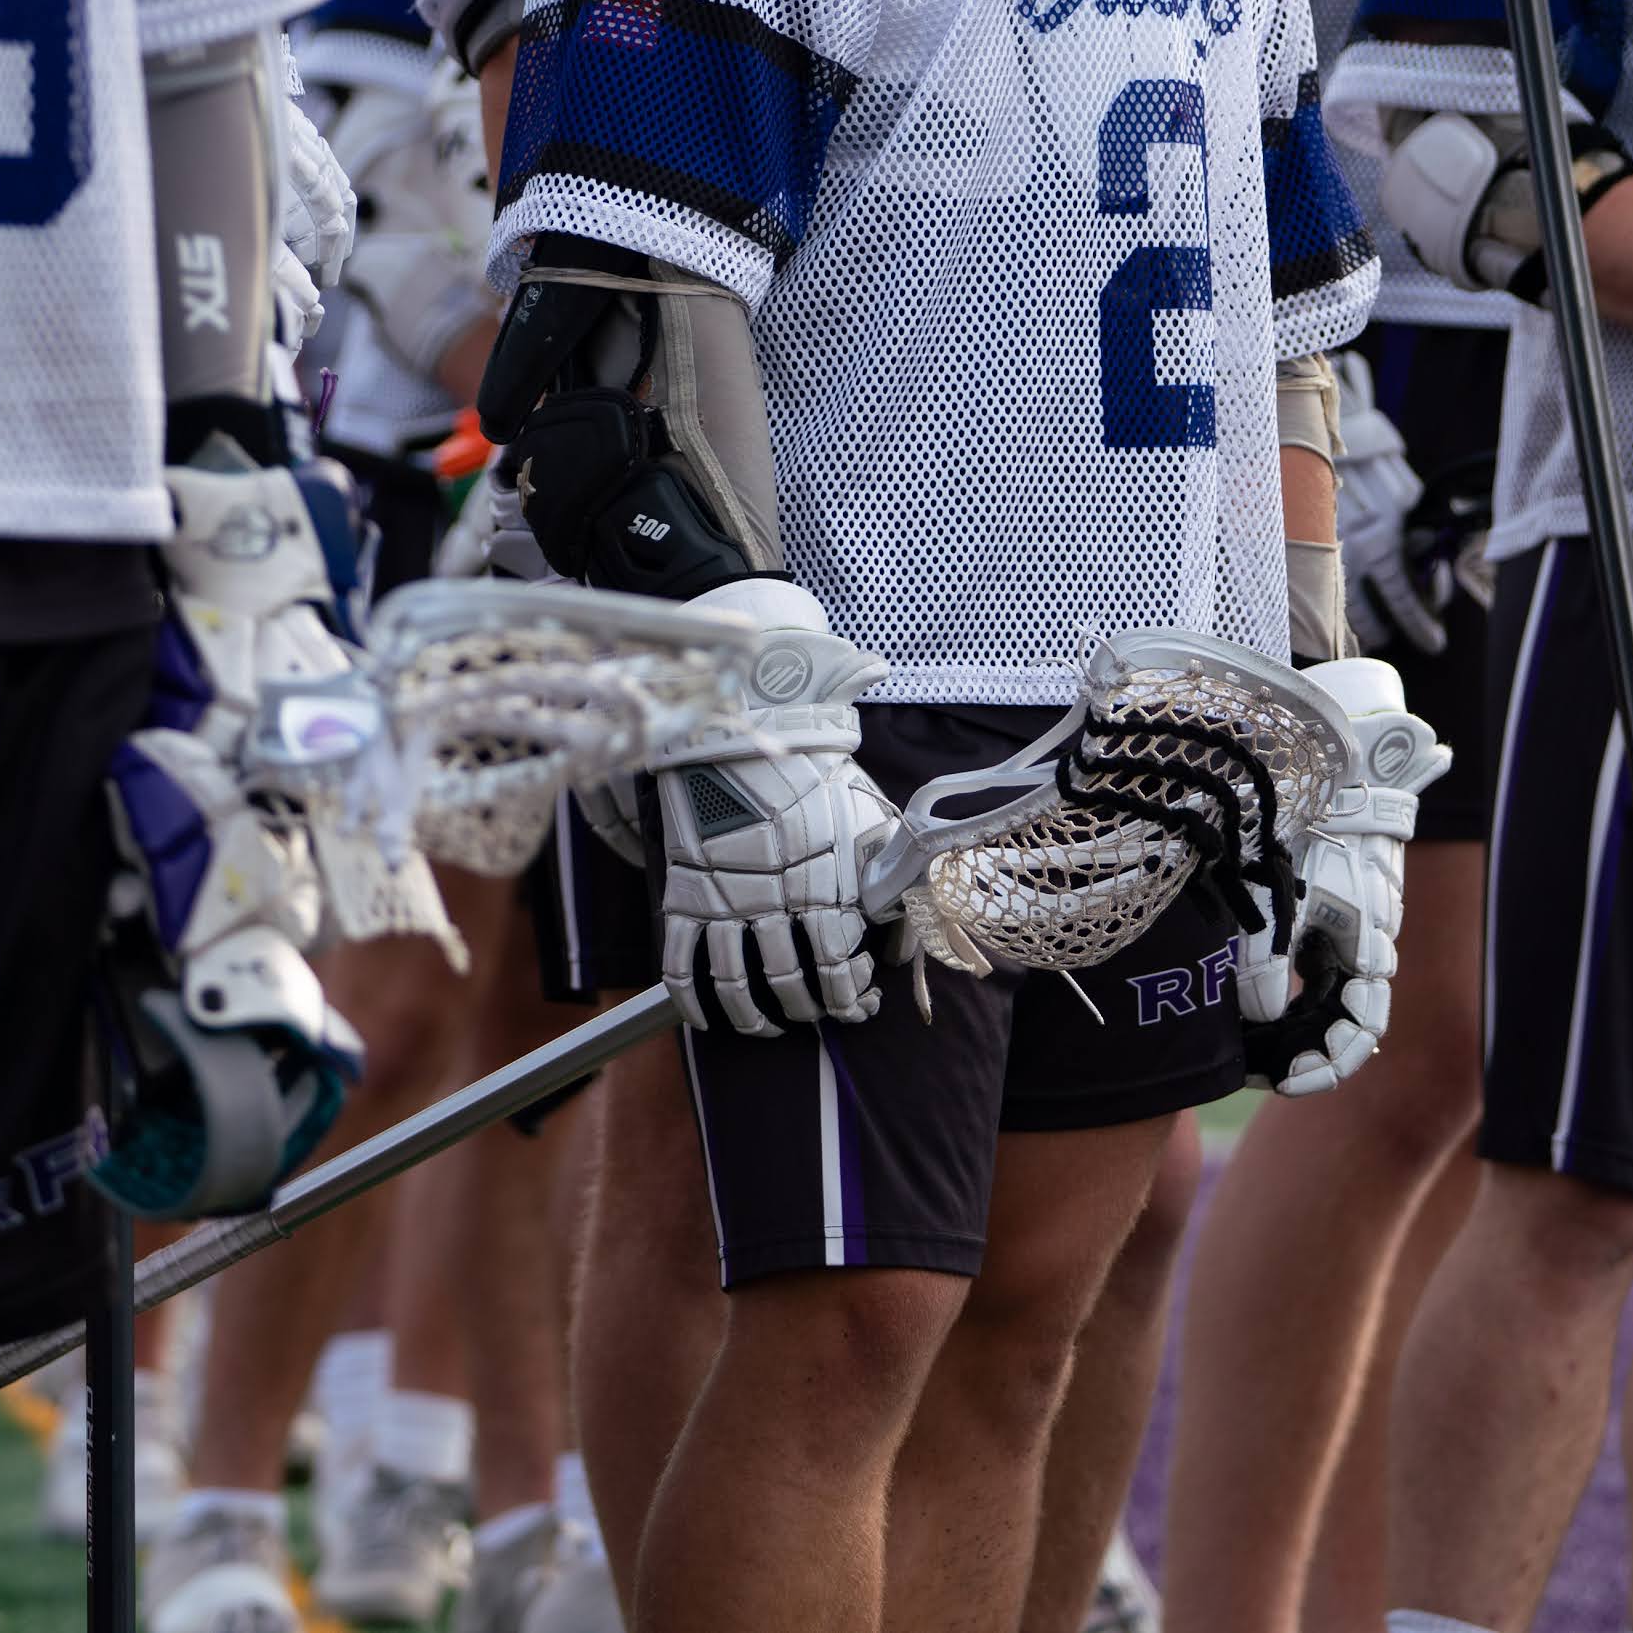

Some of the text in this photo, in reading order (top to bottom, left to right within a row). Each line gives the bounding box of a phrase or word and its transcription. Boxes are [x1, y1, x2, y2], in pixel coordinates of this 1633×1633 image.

[175, 232, 230, 333] STX
[1097, 77, 1216, 448] 2
[627, 513, 671, 542] 500
